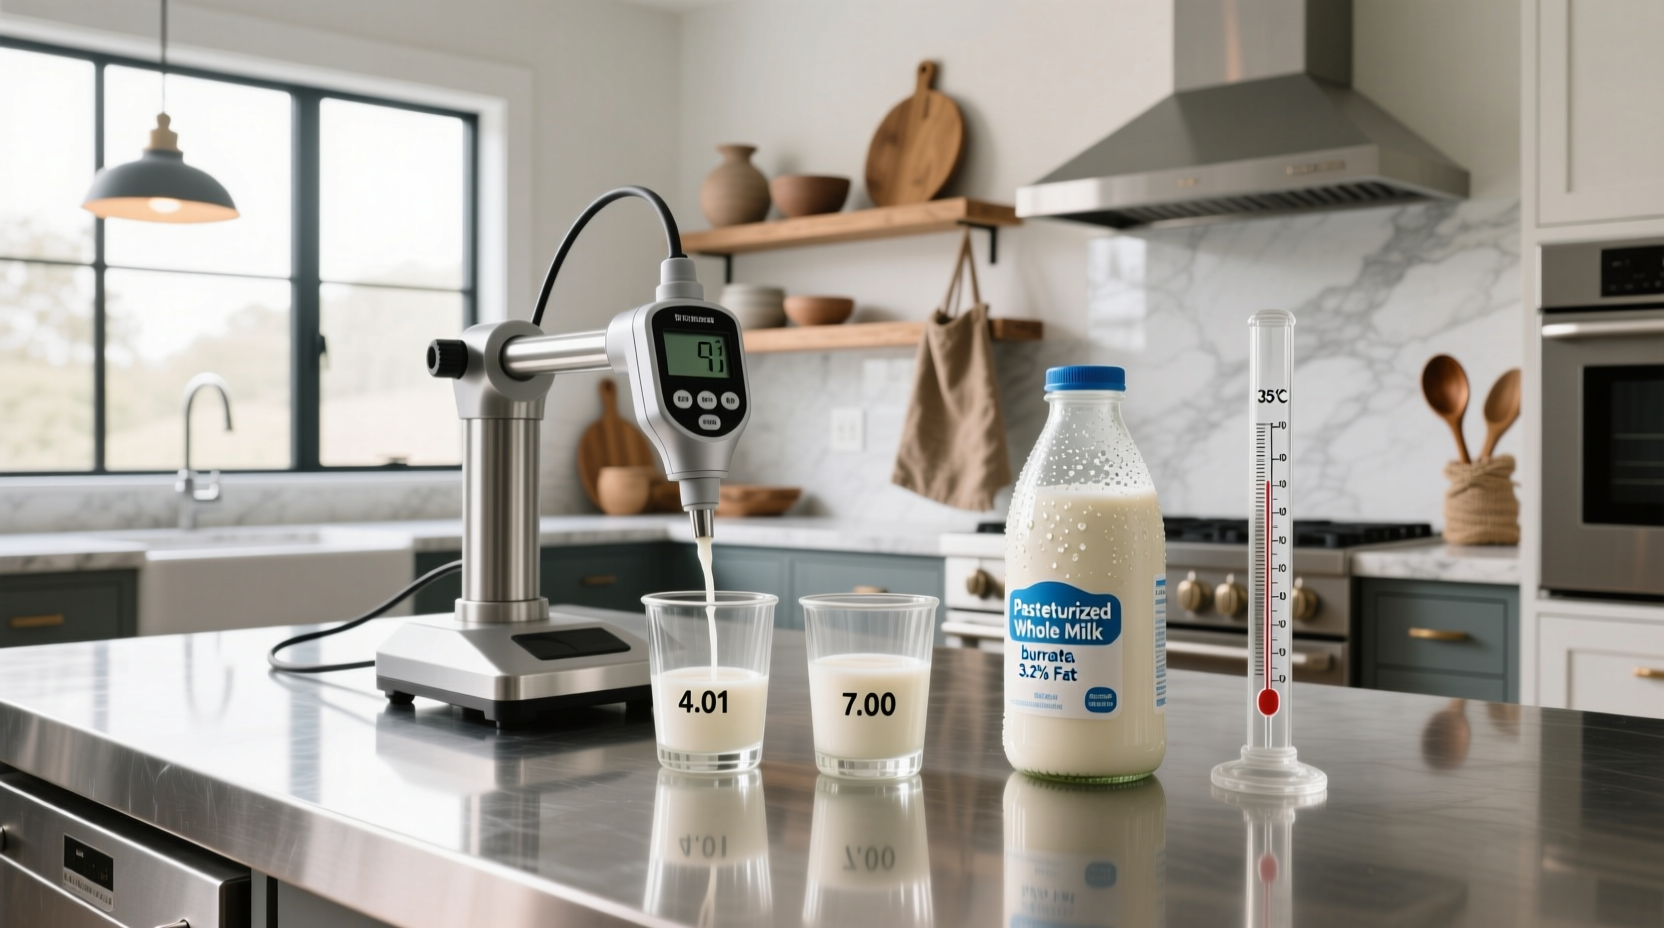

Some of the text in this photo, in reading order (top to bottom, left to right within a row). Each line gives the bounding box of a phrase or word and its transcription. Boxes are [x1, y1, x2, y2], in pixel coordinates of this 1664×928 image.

[1014, 619, 1104, 640] Whole Milk
[1018, 663, 1078, 682] 3.2% Fat
[678, 690, 728, 714] 4.01
[842, 692, 896, 716] 7.00
